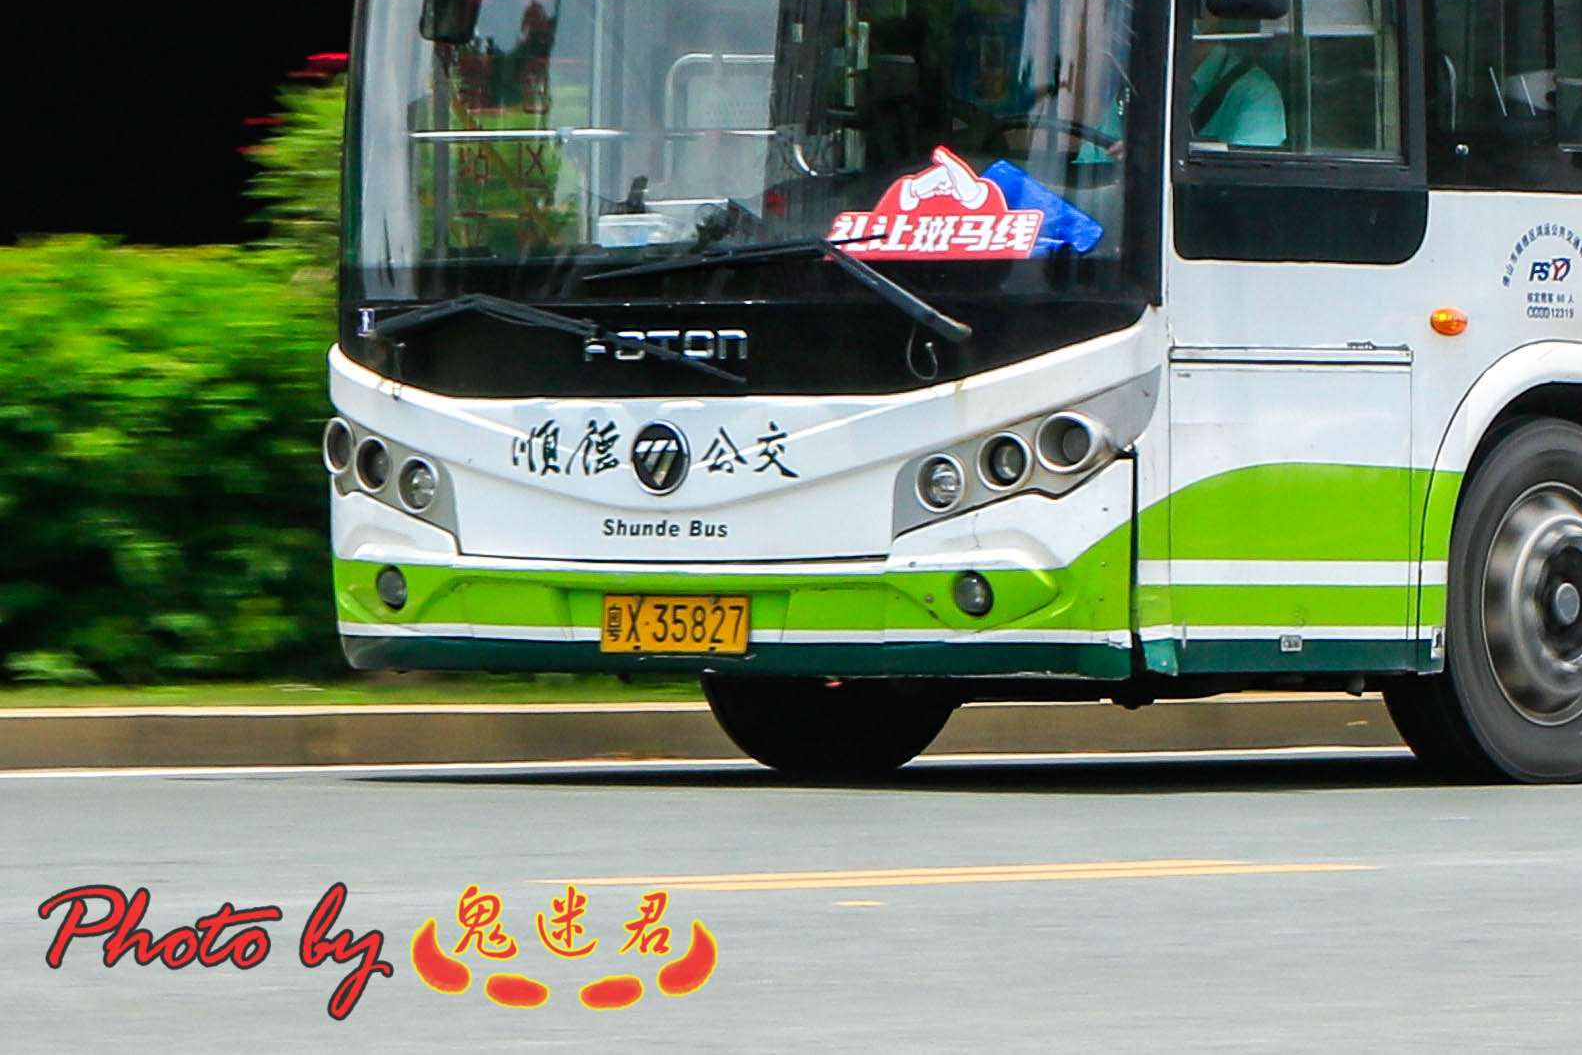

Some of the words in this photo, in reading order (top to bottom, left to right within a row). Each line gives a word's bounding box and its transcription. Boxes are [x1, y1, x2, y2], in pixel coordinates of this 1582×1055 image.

[829, 213, 1038, 252] 礼让斑马线
[702, 421, 799, 478] 公交
[602, 518, 681, 537] Shunde
[689, 520, 728, 538] Bus
